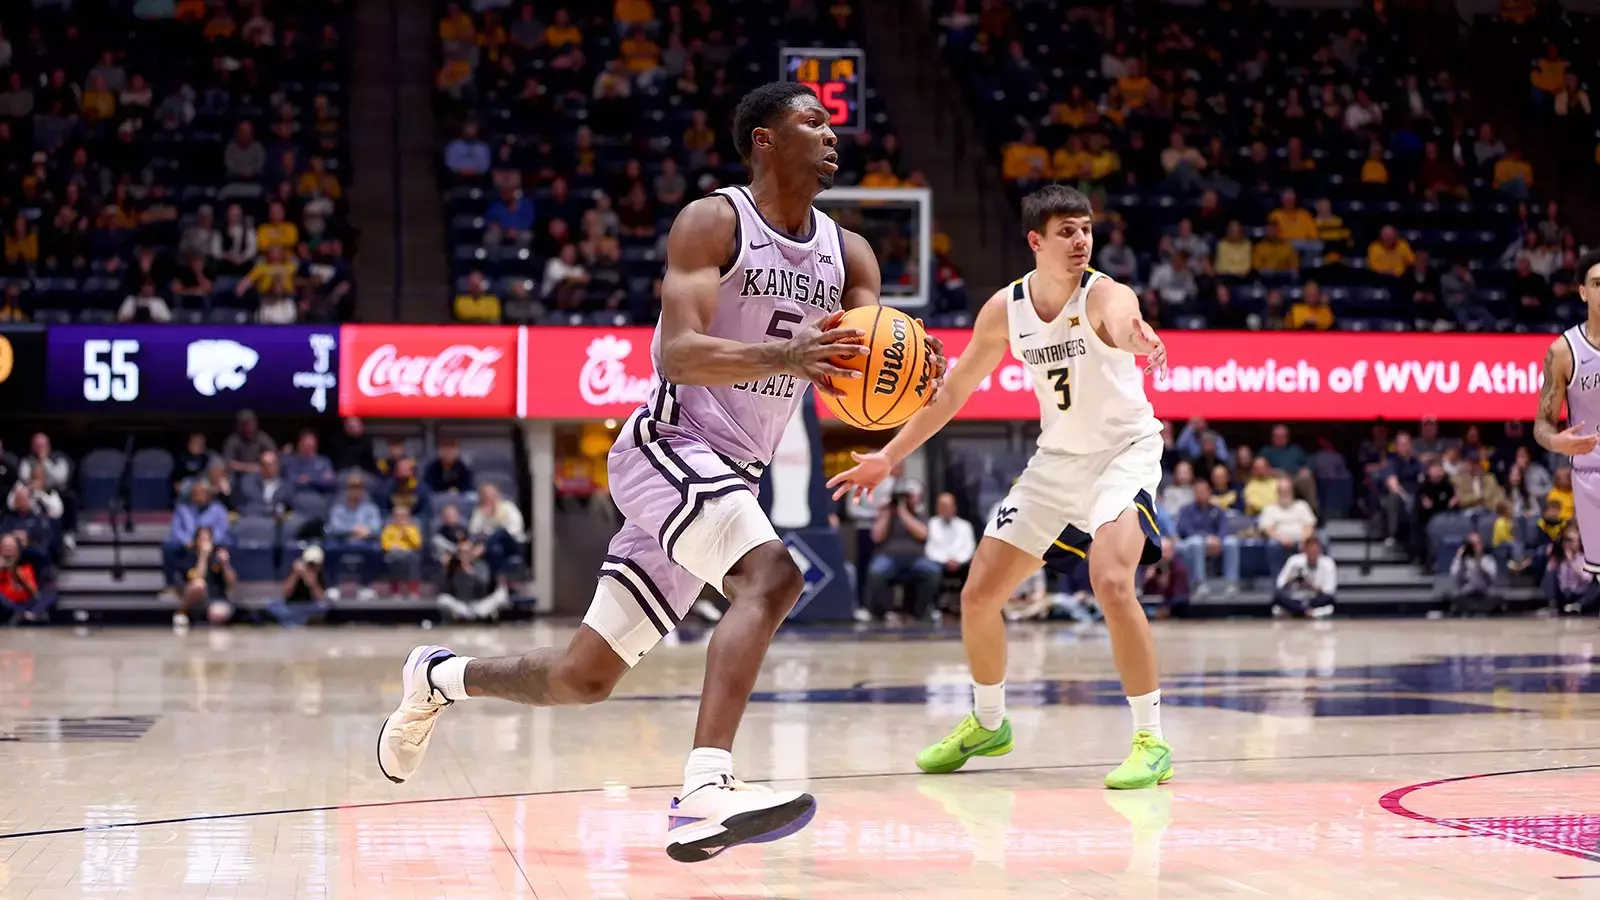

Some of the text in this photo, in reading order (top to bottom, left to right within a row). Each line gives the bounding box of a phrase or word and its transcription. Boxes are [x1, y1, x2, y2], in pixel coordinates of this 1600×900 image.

[802, 81, 848, 125] 5
[740, 268, 840, 314] KANSAS
[765, 309, 804, 341] 5
[83, 339, 140, 401] 55
[357, 344, 504, 398] Coca-Cola
[874, 318, 906, 395] Wilson
[1153, 358, 1321, 393] sandwich
[1328, 360, 1367, 393] of
[1374, 360, 1460, 393] WVU
[1467, 360, 1544, 393] Athl
[1047, 367, 1072, 411] 3
